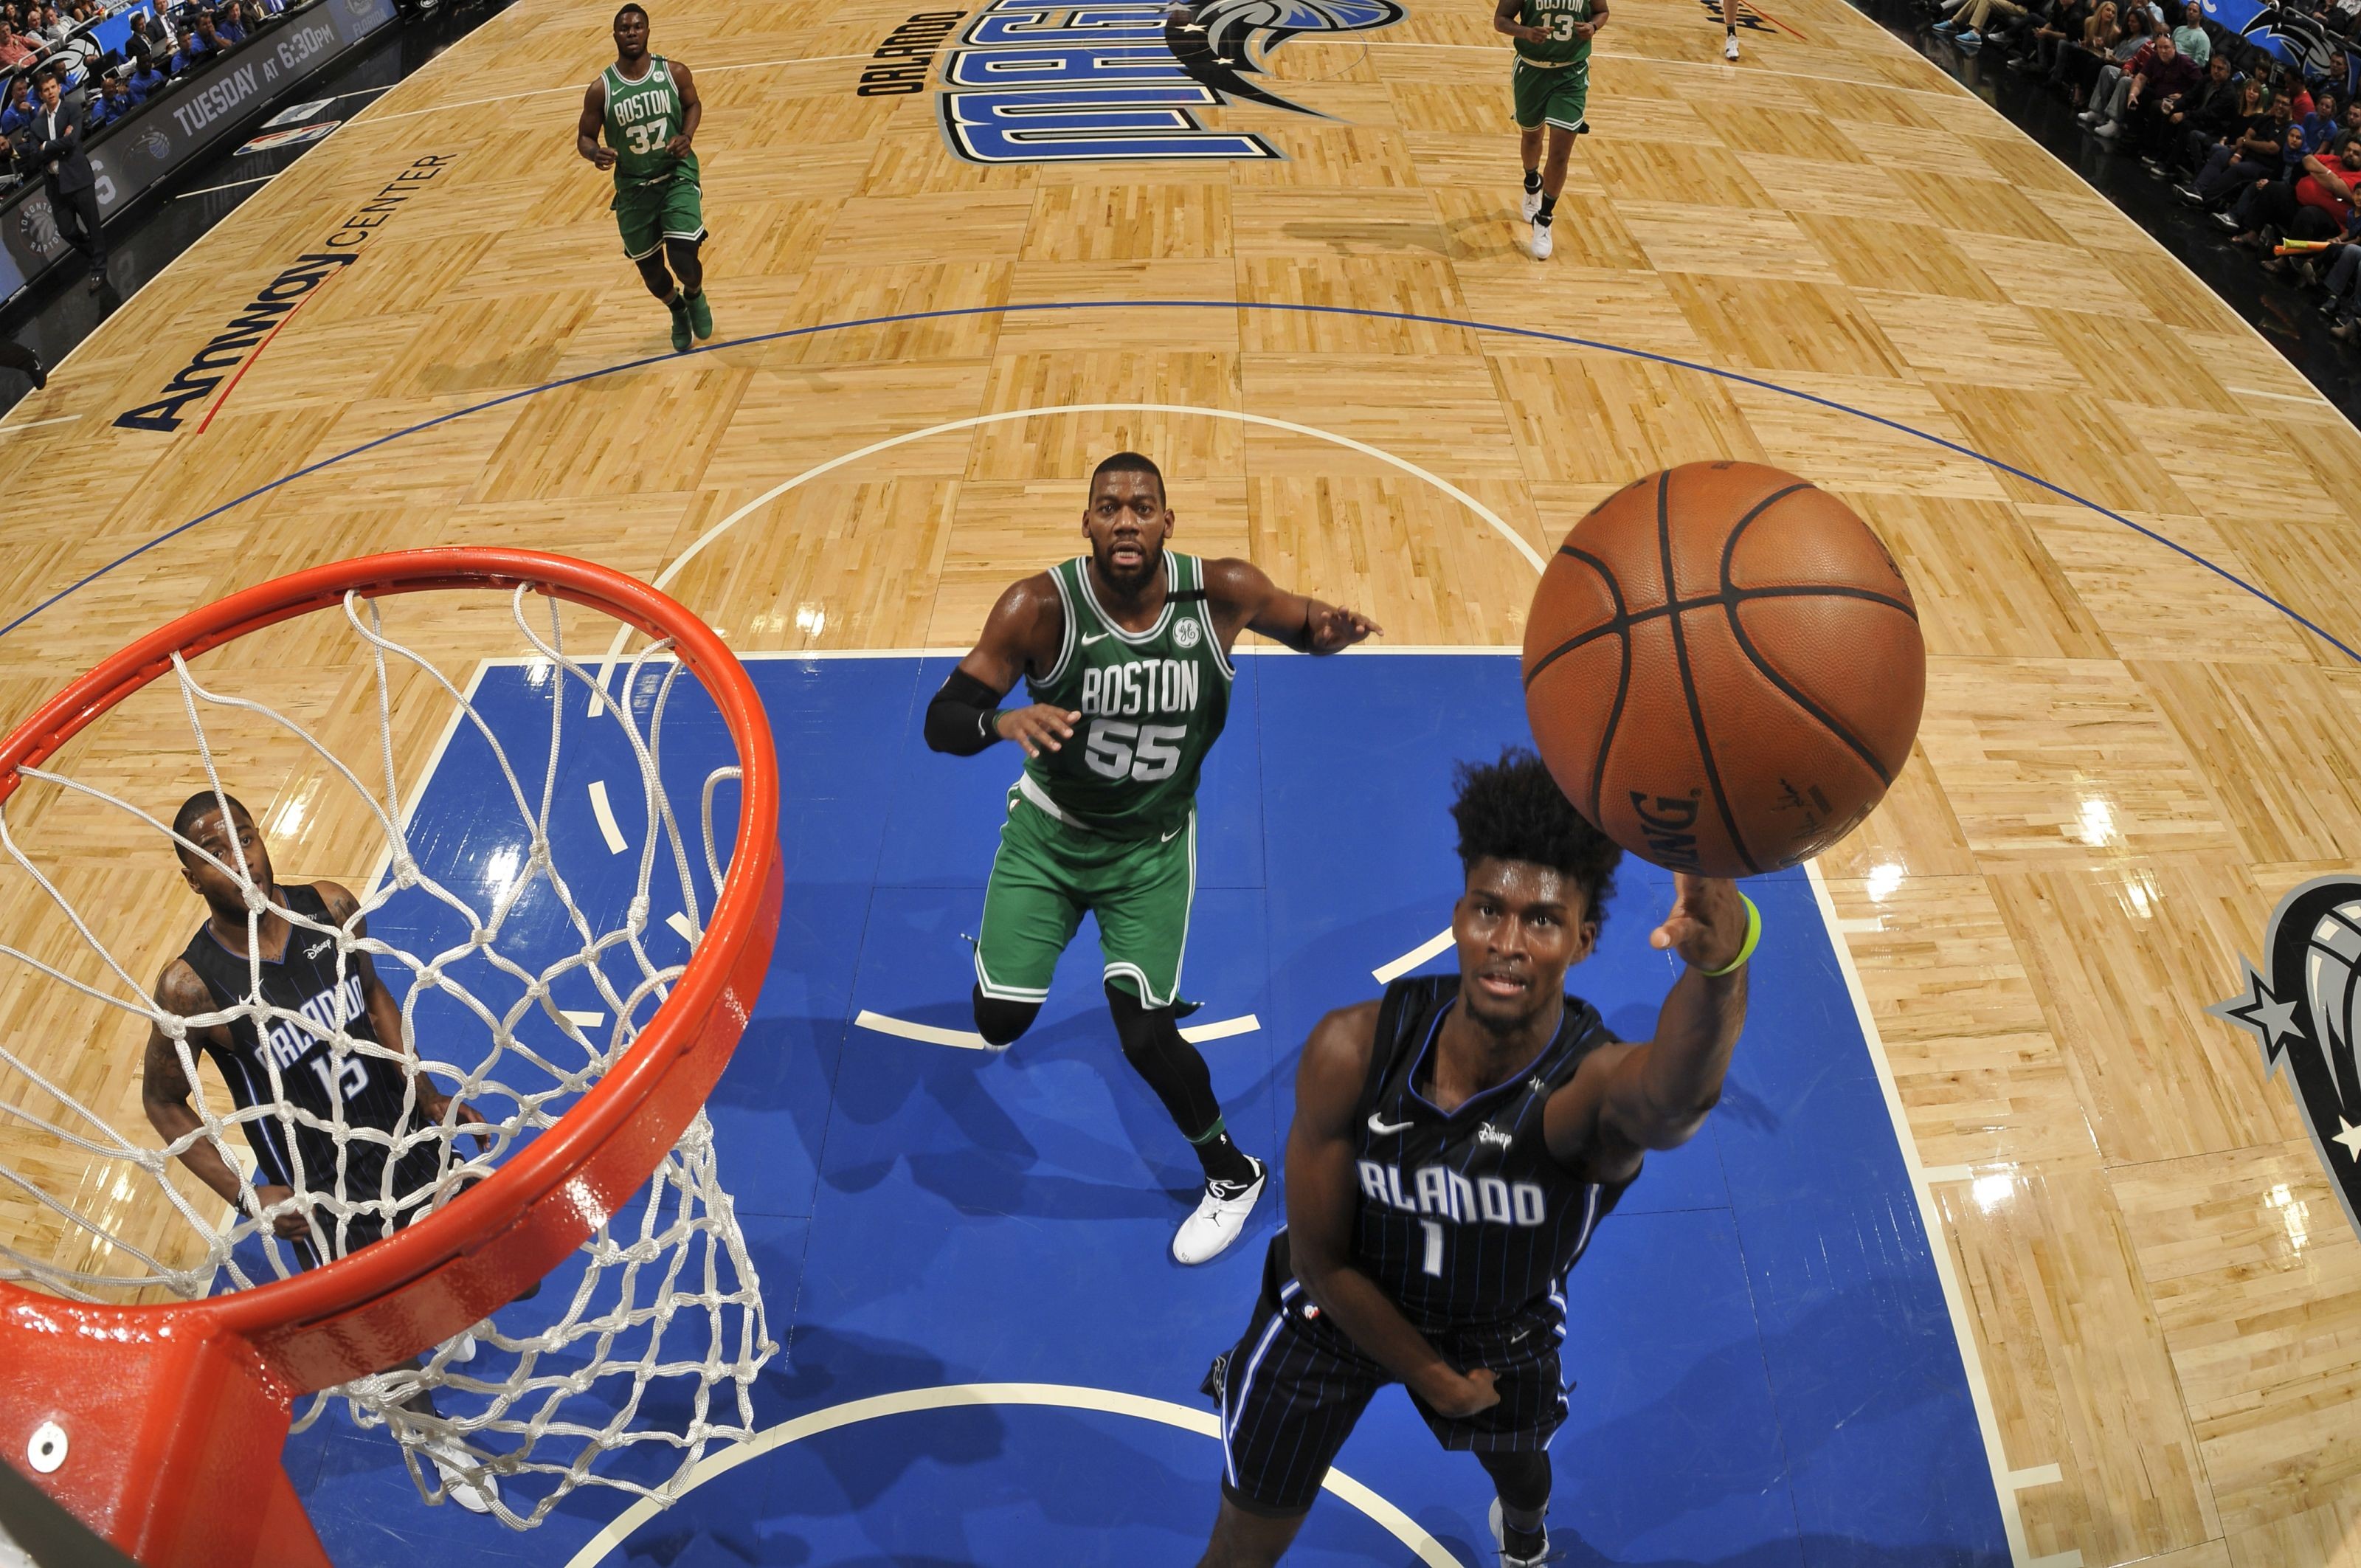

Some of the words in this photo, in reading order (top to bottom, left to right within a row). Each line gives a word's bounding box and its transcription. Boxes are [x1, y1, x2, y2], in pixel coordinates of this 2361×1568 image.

[353, 8, 388, 37] FLORIDA
[1541, 13, 1574, 41] 13
[173, 63, 258, 137] TUESDAY
[262, 58, 280, 83] AT
[277, 24, 335, 70] 6:30PM
[857, 11, 968, 96] ORLANDO
[614, 89, 671, 127] BOSTON
[626, 117, 668, 154] 37
[325, 153, 458, 248] CENTER
[1082, 658, 1199, 716] BOSTON
[1085, 718, 1187, 782] 55
[310, 1050, 369, 1101] 15
[1356, 1159, 1547, 1226] RLANDO
[1419, 1218, 1444, 1277] 1
